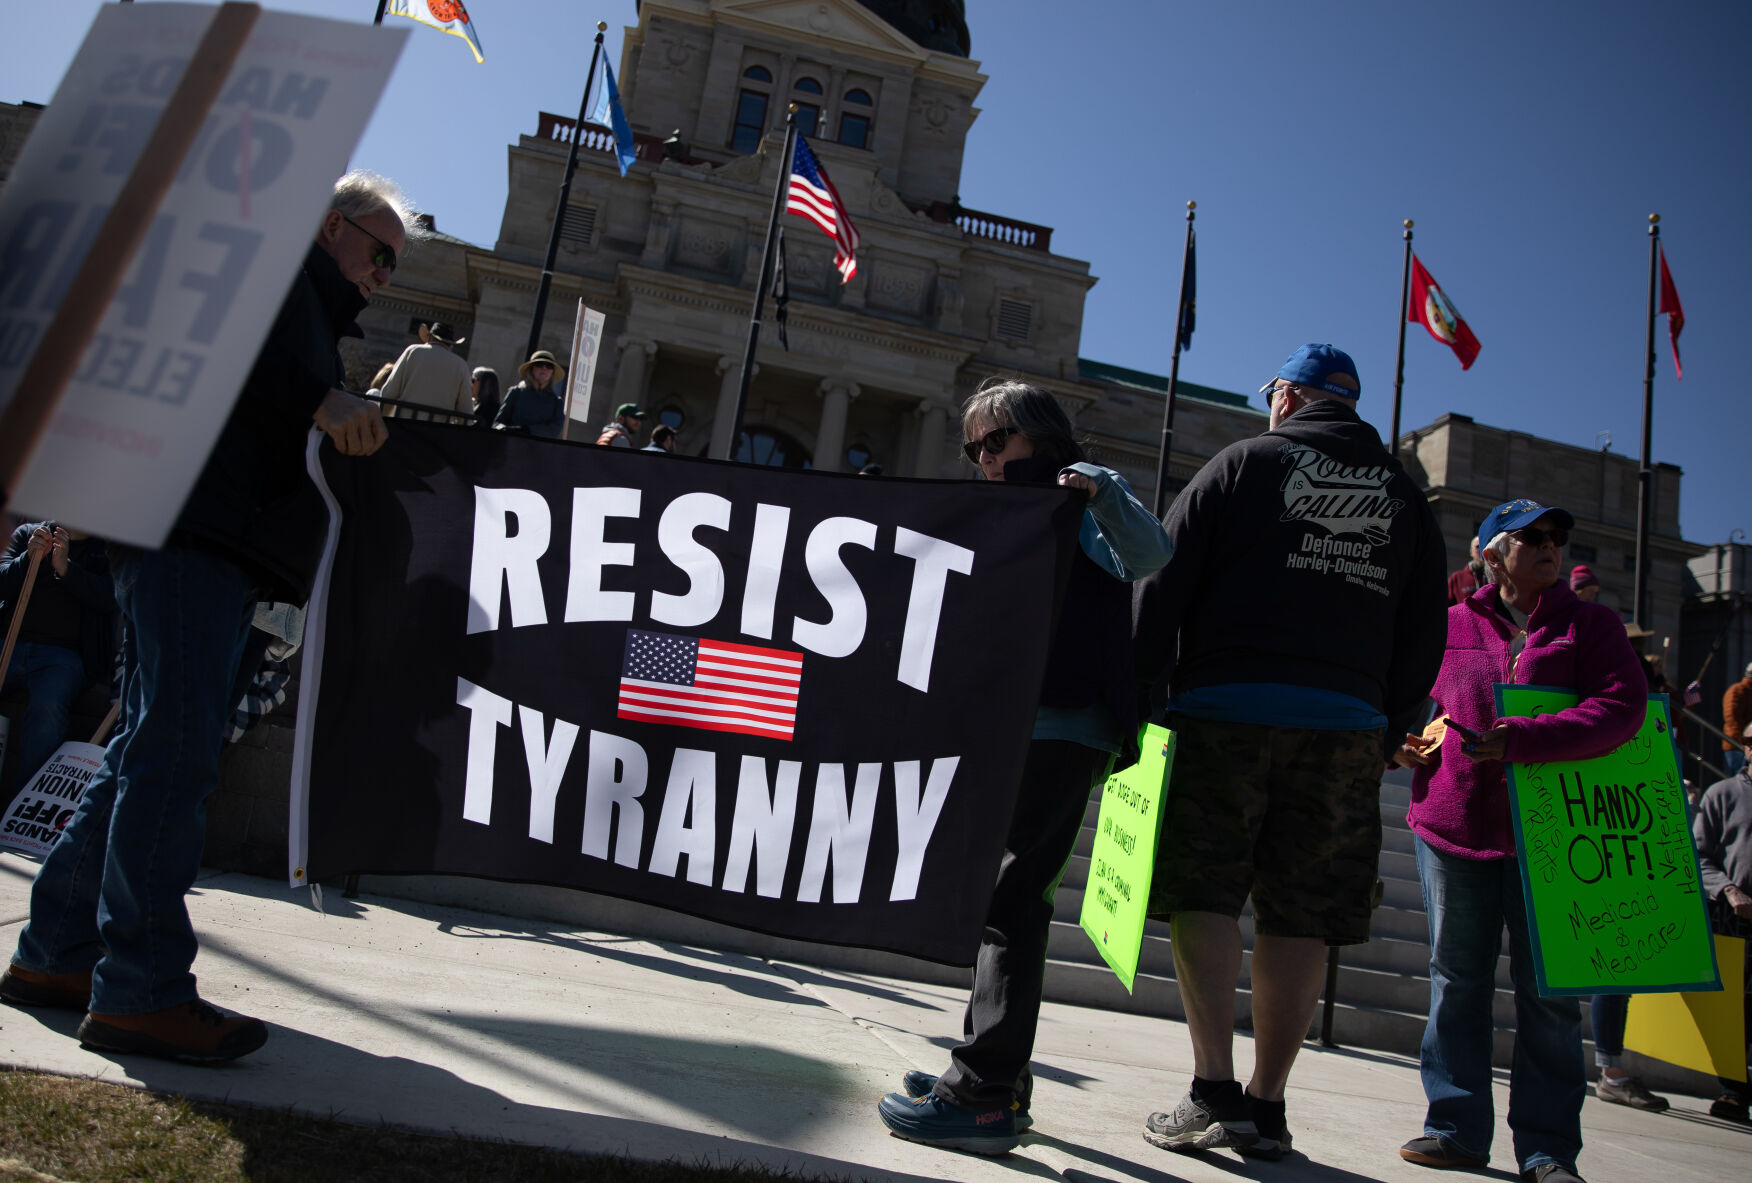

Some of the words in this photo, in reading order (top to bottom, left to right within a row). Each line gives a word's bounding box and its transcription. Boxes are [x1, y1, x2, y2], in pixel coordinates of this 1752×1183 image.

[1280, 494, 1406, 522] CALLING
[1292, 480, 1304, 490] IS
[1286, 552, 1388, 580] Harley-Davidson
[1301, 533, 1372, 559] Defiance
[466, 485, 975, 693] RESIST
[46, 763, 96, 784] NTRACTS
[456, 676, 961, 904] TYRANNY
[1666, 762, 1682, 816] Care
[12, 797, 76, 831] OFF!
[1130, 790, 1142, 813] OUT
[1141, 797, 1151, 816] OF
[1558, 771, 1654, 835] HANDS
[1525, 809, 1559, 884] Rights
[1651, 780, 1677, 878] Veteran
[1567, 834, 1655, 884] OFF!
[1672, 821, 1698, 895] Health
[1568, 887, 1659, 941] Medicaid
[1615, 927, 1630, 948] &
[1590, 918, 1687, 982] Medicare
[976, 1110, 1004, 1127] HOKA
